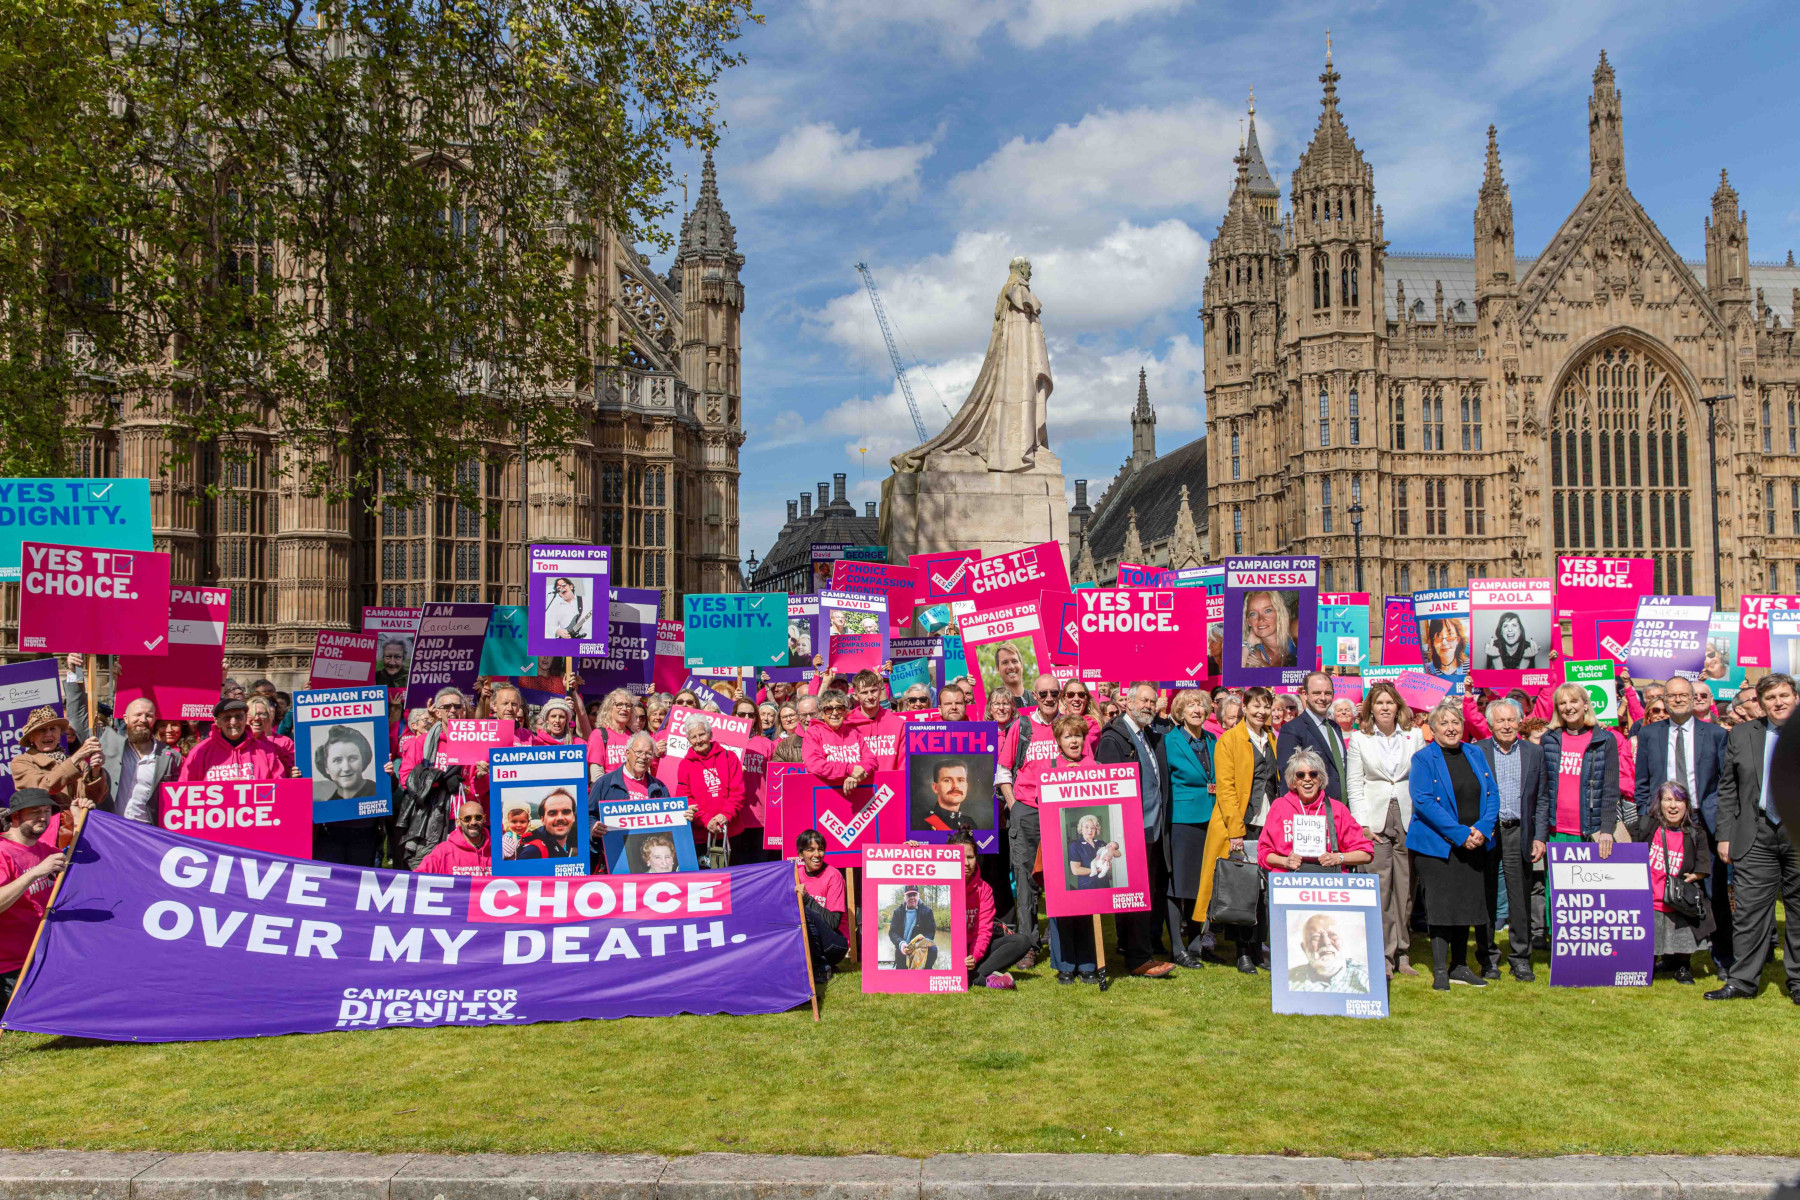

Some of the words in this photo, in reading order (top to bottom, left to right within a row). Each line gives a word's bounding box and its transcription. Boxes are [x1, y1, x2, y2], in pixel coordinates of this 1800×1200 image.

[0, 483, 55, 503] YES
[0, 506, 126, 526] DIGNITY.
[27, 547, 83, 572] YES
[533, 549, 585, 559] CAMPAIGN
[588, 550, 607, 559] FOR
[846, 551, 886, 560] GEORGE.
[537, 562, 559, 572] Tom
[848, 564, 887, 576] CHOICE
[967, 558, 1006, 579] YES
[1228, 560, 1290, 571] CAMPAIGN
[1293, 560, 1316, 570] FOR
[1561, 559, 1598, 573] YES
[26, 571, 138, 600] CHOICE.
[846, 575, 914, 589] COMPASSION
[972, 566, 1046, 594] CHOICE.
[1236, 574, 1308, 585] VANESSA
[1472, 582, 1527, 590] CAMPAIGN
[1529, 581, 1550, 590] FOR
[1560, 574, 1633, 589] CHOICE.
[170, 590, 226, 606] PAIGN
[821, 592, 867, 601] CAMPAIGN
[1081, 592, 1131, 612] YES
[1414, 591, 1456, 603] CAMPAIGN
[1458, 591, 1470, 600] FO
[1489, 592, 1534, 603] PAOLA
[1649, 598, 1671, 606] AM
[425, 606, 431, 617] I
[433, 606, 454, 616] AM
[688, 597, 726, 612] YES
[837, 600, 871, 609] DAVID
[1428, 602, 1458, 612] JANE
[1744, 598, 1787, 612] YES
[365, 609, 411, 618] CAMPAIGN
[688, 612, 772, 629] DIGNITY.
[961, 609, 1013, 626] CAMPAIGN
[1015, 604, 1037, 616] FOR
[381, 619, 412, 628] MAVIS
[987, 622, 1015, 636] ROB
[1081, 612, 1180, 633] CHOICE.
[1636, 621, 1667, 630] AND
[319, 634, 375, 650] CAMPAIGN
[1634, 630, 1698, 640] SUPPORT
[417, 639, 446, 649] AND
[448, 639, 454, 649] I
[1631, 638, 1700, 651] ASSISTED
[317, 645, 343, 658] FOR:
[415, 649, 474, 660] SUPPORT
[896, 649, 935, 657] PAMELA
[1630, 648, 1677, 660] DYING.
[412, 660, 475, 673] ASSISTED
[583, 659, 628, 671] DYING.
[1363, 668, 1402, 676] CAMPAIGN
[1585, 664, 1608, 672] about
[411, 673, 454, 685] DYING.
[1577, 671, 1603, 680] choice
[297, 692, 359, 705] CAMPAIGN
[362, 689, 385, 701] FOR
[694, 688, 715, 702] AM
[311, 704, 373, 719] DOREEN
[449, 721, 476, 731] YES
[449, 731, 500, 743] CHOICE.
[909, 732, 995, 754] KEITH.
[492, 751, 557, 764] CAMPAIGN
[559, 750, 584, 761] FOR
[497, 769, 517, 779] Ian
[1040, 770, 1107, 783] CAMPAIGN
[1109, 767, 1135, 778] FOR
[163, 785, 224, 807] YES
[1059, 783, 1119, 798] WINNIE
[603, 803, 661, 816] CAMPAIGN
[663, 800, 685, 811] FOR
[163, 806, 281, 831] CHOICE.
[619, 814, 674, 829] STELLA
[823, 813, 845, 836] YES
[840, 826, 857, 843] TO
[852, 788, 891, 834] DIGNITY
[867, 849, 932, 860] CAMPAIGN
[936, 848, 961, 860] FOR
[1551, 847, 1558, 861] I
[1564, 847, 1591, 861] AM
[892, 864, 937, 877] GREG
[1571, 865, 1615, 885] Rosie
[159, 846, 332, 907] GIVE
[356, 870, 455, 916] ME
[479, 878, 723, 919] CHOICE
[1273, 876, 1344, 888] CAMPAIGN
[1347, 877, 1375, 889] FOR
[1298, 891, 1351, 904] GILES
[1556, 893, 1594, 908] AND
[1599, 893, 1606, 908] I
[1556, 909, 1641, 925] SUPPORT
[142, 900, 343, 960] OVER
[369, 925, 478, 966] MY
[503, 921, 747, 965] DEATH.
[1556, 926, 1646, 941] ASSISTED
[1556, 942, 1618, 958] DYING.
[343, 987, 465, 1001] CAMPAIGN
[473, 989, 518, 1001] FOR
[338, 999, 518, 1020] DIGNITY
